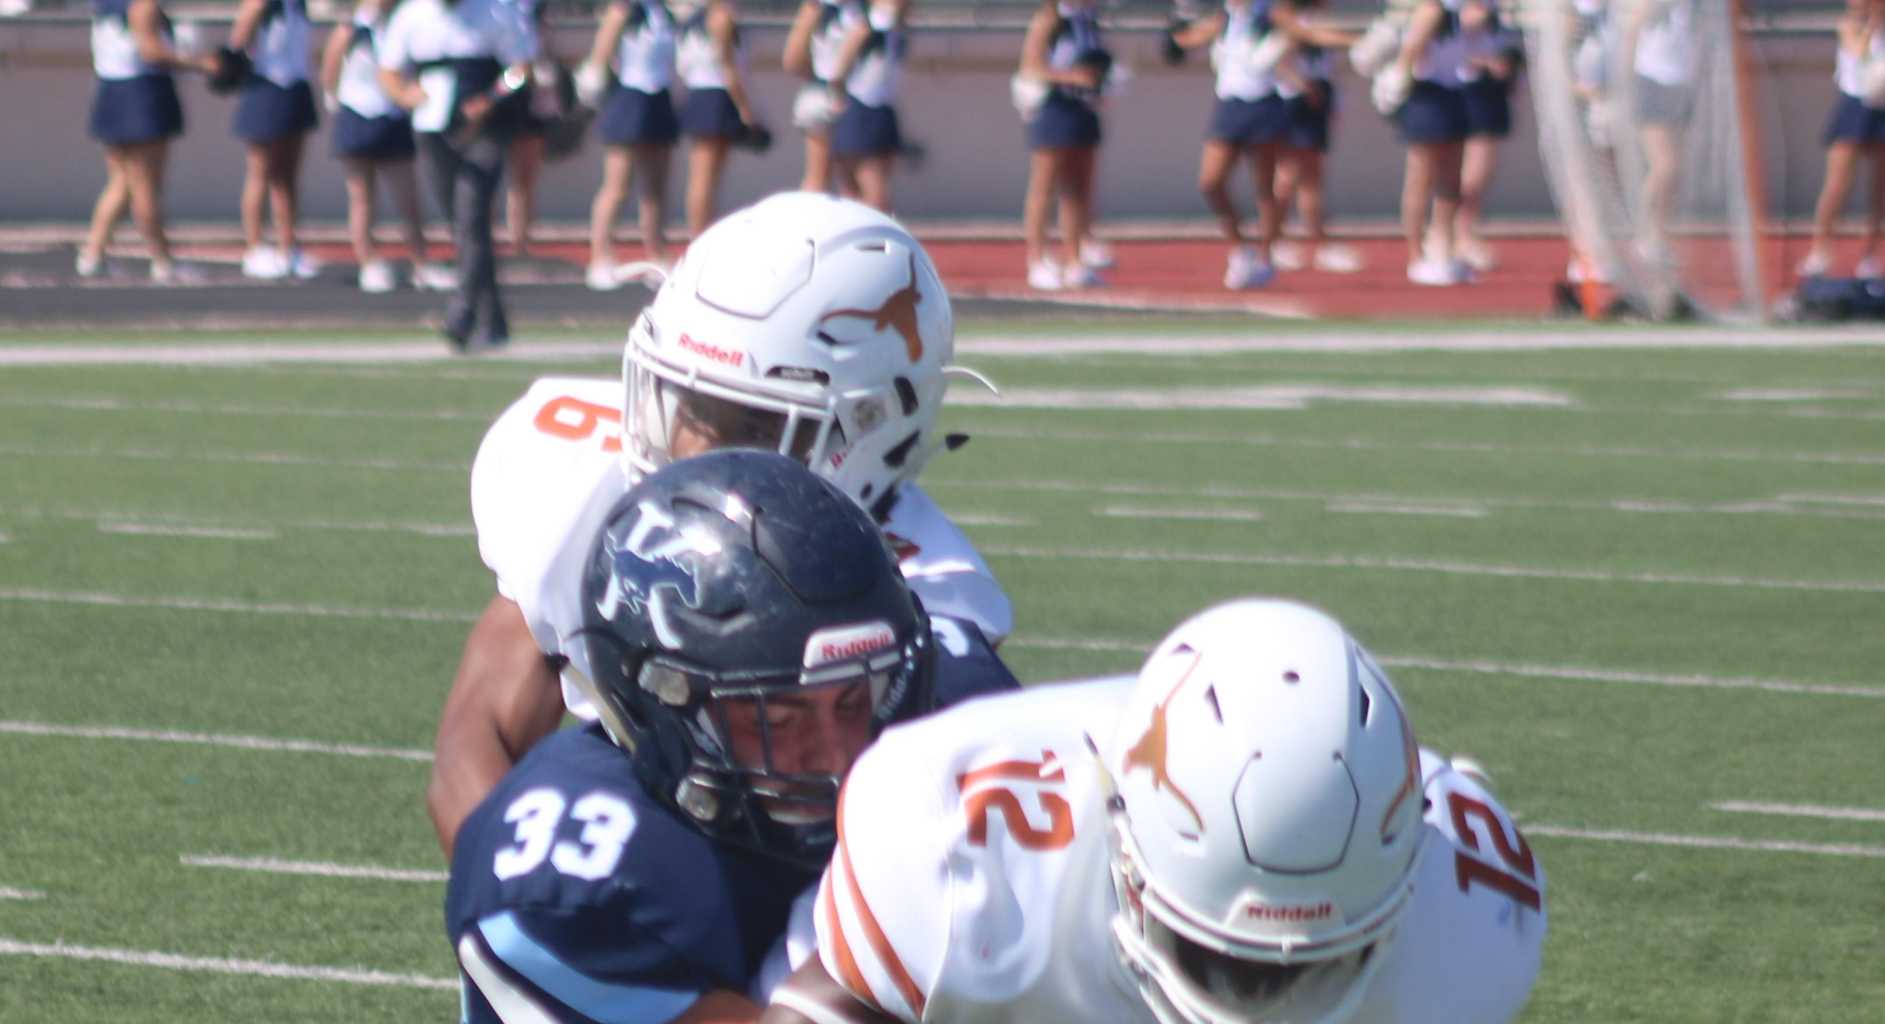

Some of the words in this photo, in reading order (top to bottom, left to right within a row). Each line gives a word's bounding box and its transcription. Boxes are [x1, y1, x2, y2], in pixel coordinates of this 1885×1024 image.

[678, 332, 744, 368] Riddell
[821, 632, 892, 662] Riddell
[956, 748, 1075, 852] 12
[493, 787, 637, 881] 33
[1446, 791, 1541, 912] 12
[1247, 900, 1332, 920] Riddell
